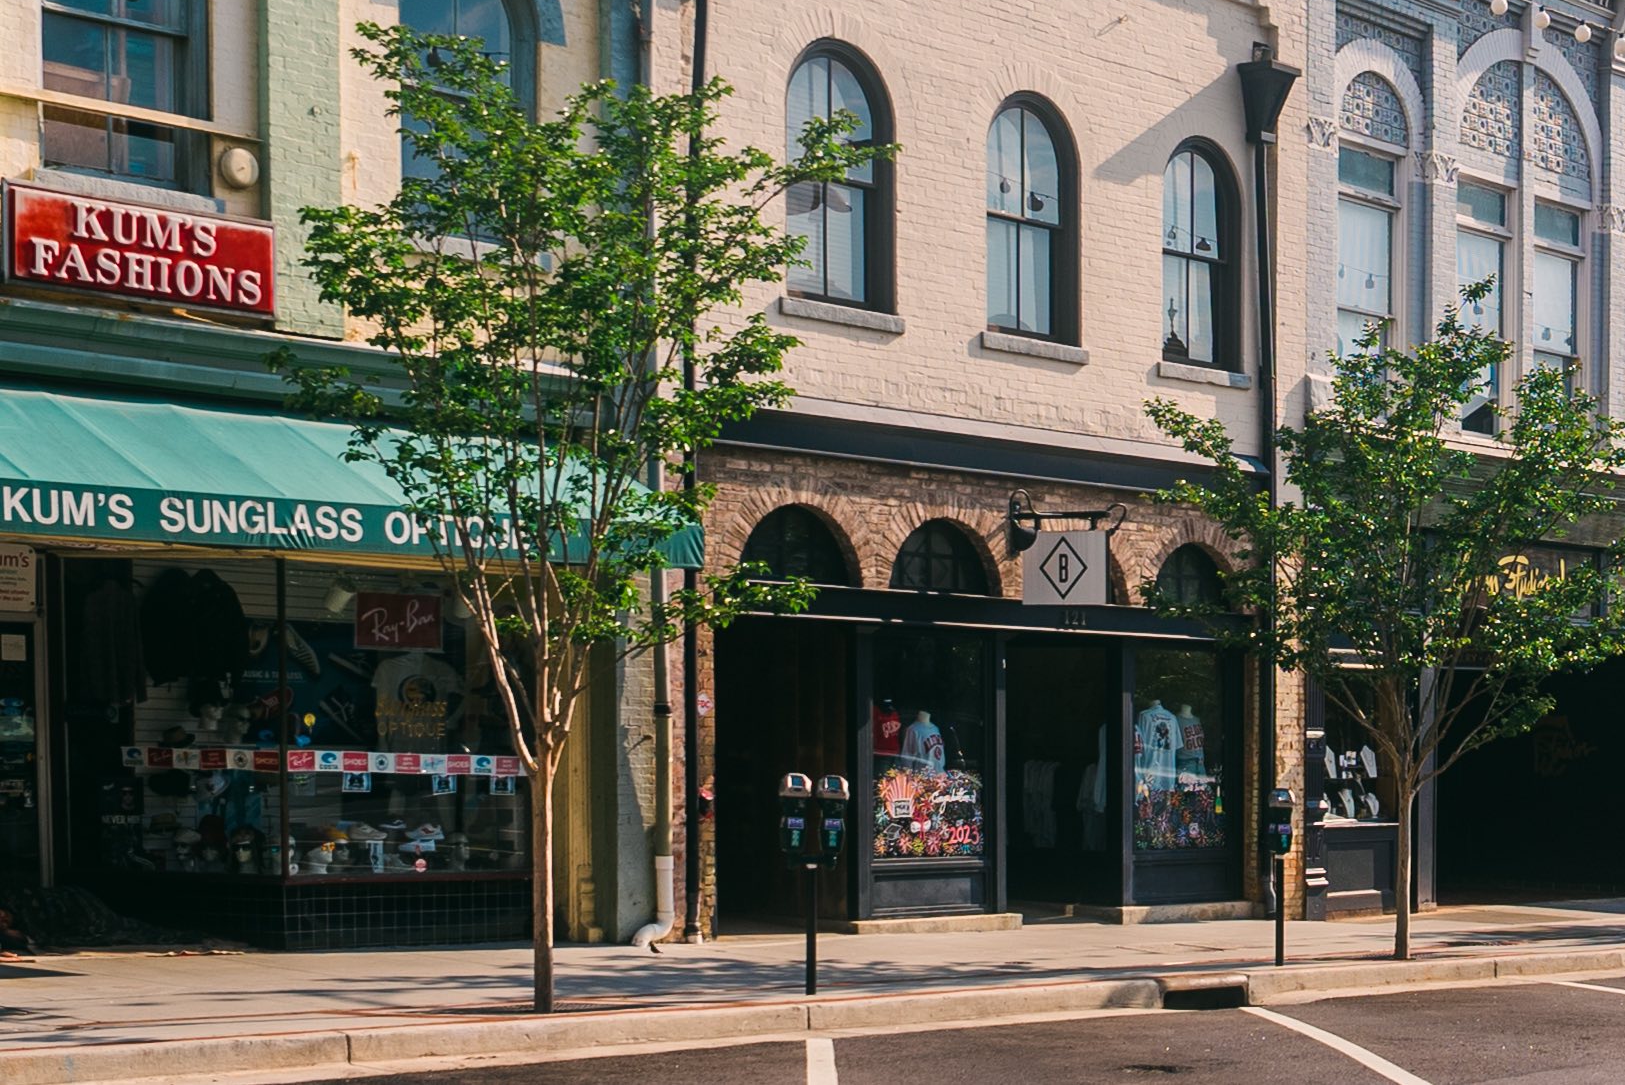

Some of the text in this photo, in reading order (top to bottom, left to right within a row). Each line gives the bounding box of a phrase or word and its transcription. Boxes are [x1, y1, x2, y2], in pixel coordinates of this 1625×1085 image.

[72, 201, 217, 257] KUM'S
[30, 237, 262, 306] FASHIONS
[2, 486, 134, 530] KUM'S
[160, 497, 363, 542] SUNGLASS
[1059, 554, 1068, 583] B
[361, 599, 435, 642] Ray-Ban
[1064, 610, 1086, 626] 121
[949, 825, 980, 845] 2023
